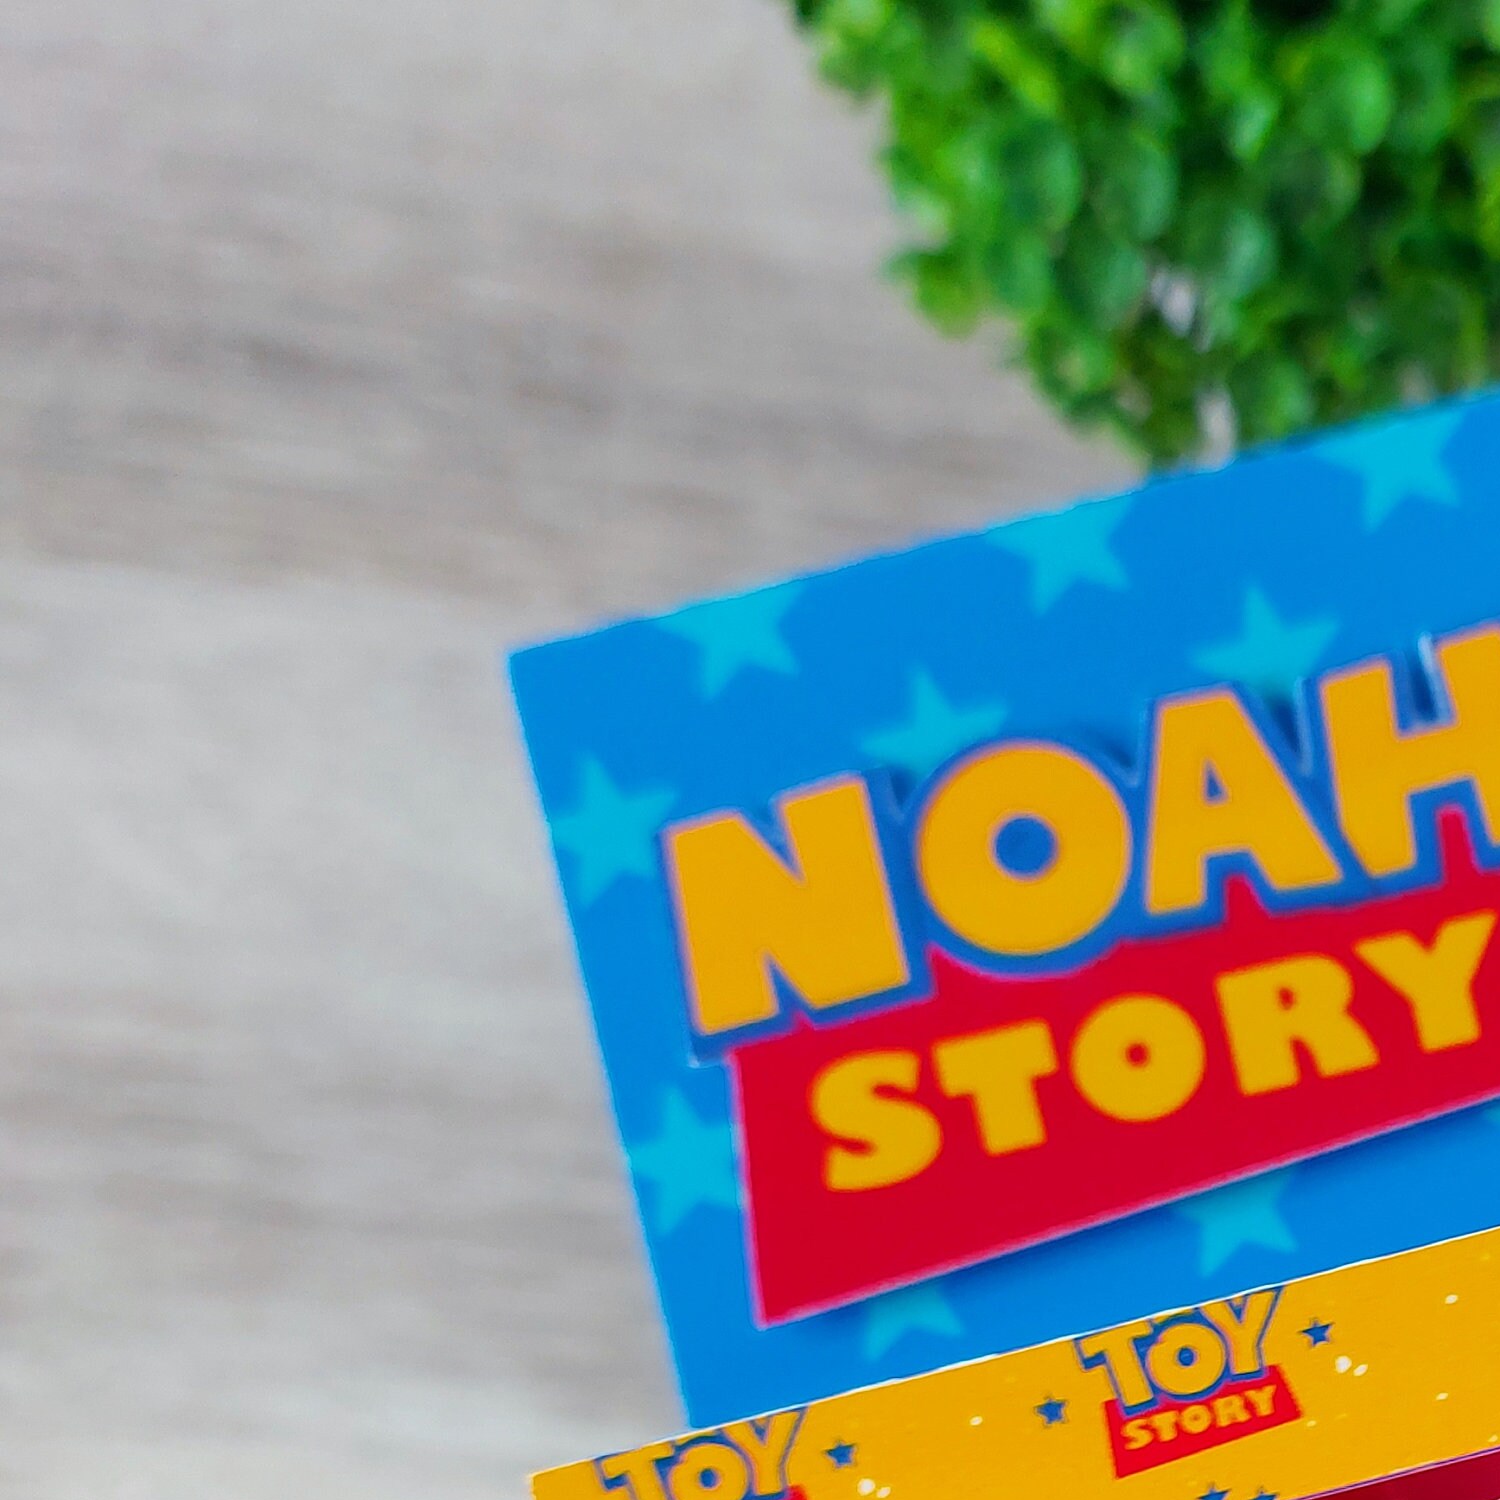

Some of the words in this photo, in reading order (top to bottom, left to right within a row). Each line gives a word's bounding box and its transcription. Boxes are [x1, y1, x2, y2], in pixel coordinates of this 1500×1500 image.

[808, 908, 1499, 1194] STORY
[1073, 1285, 1286, 1415] TOY
[1118, 1384, 1277, 1452] STORY
